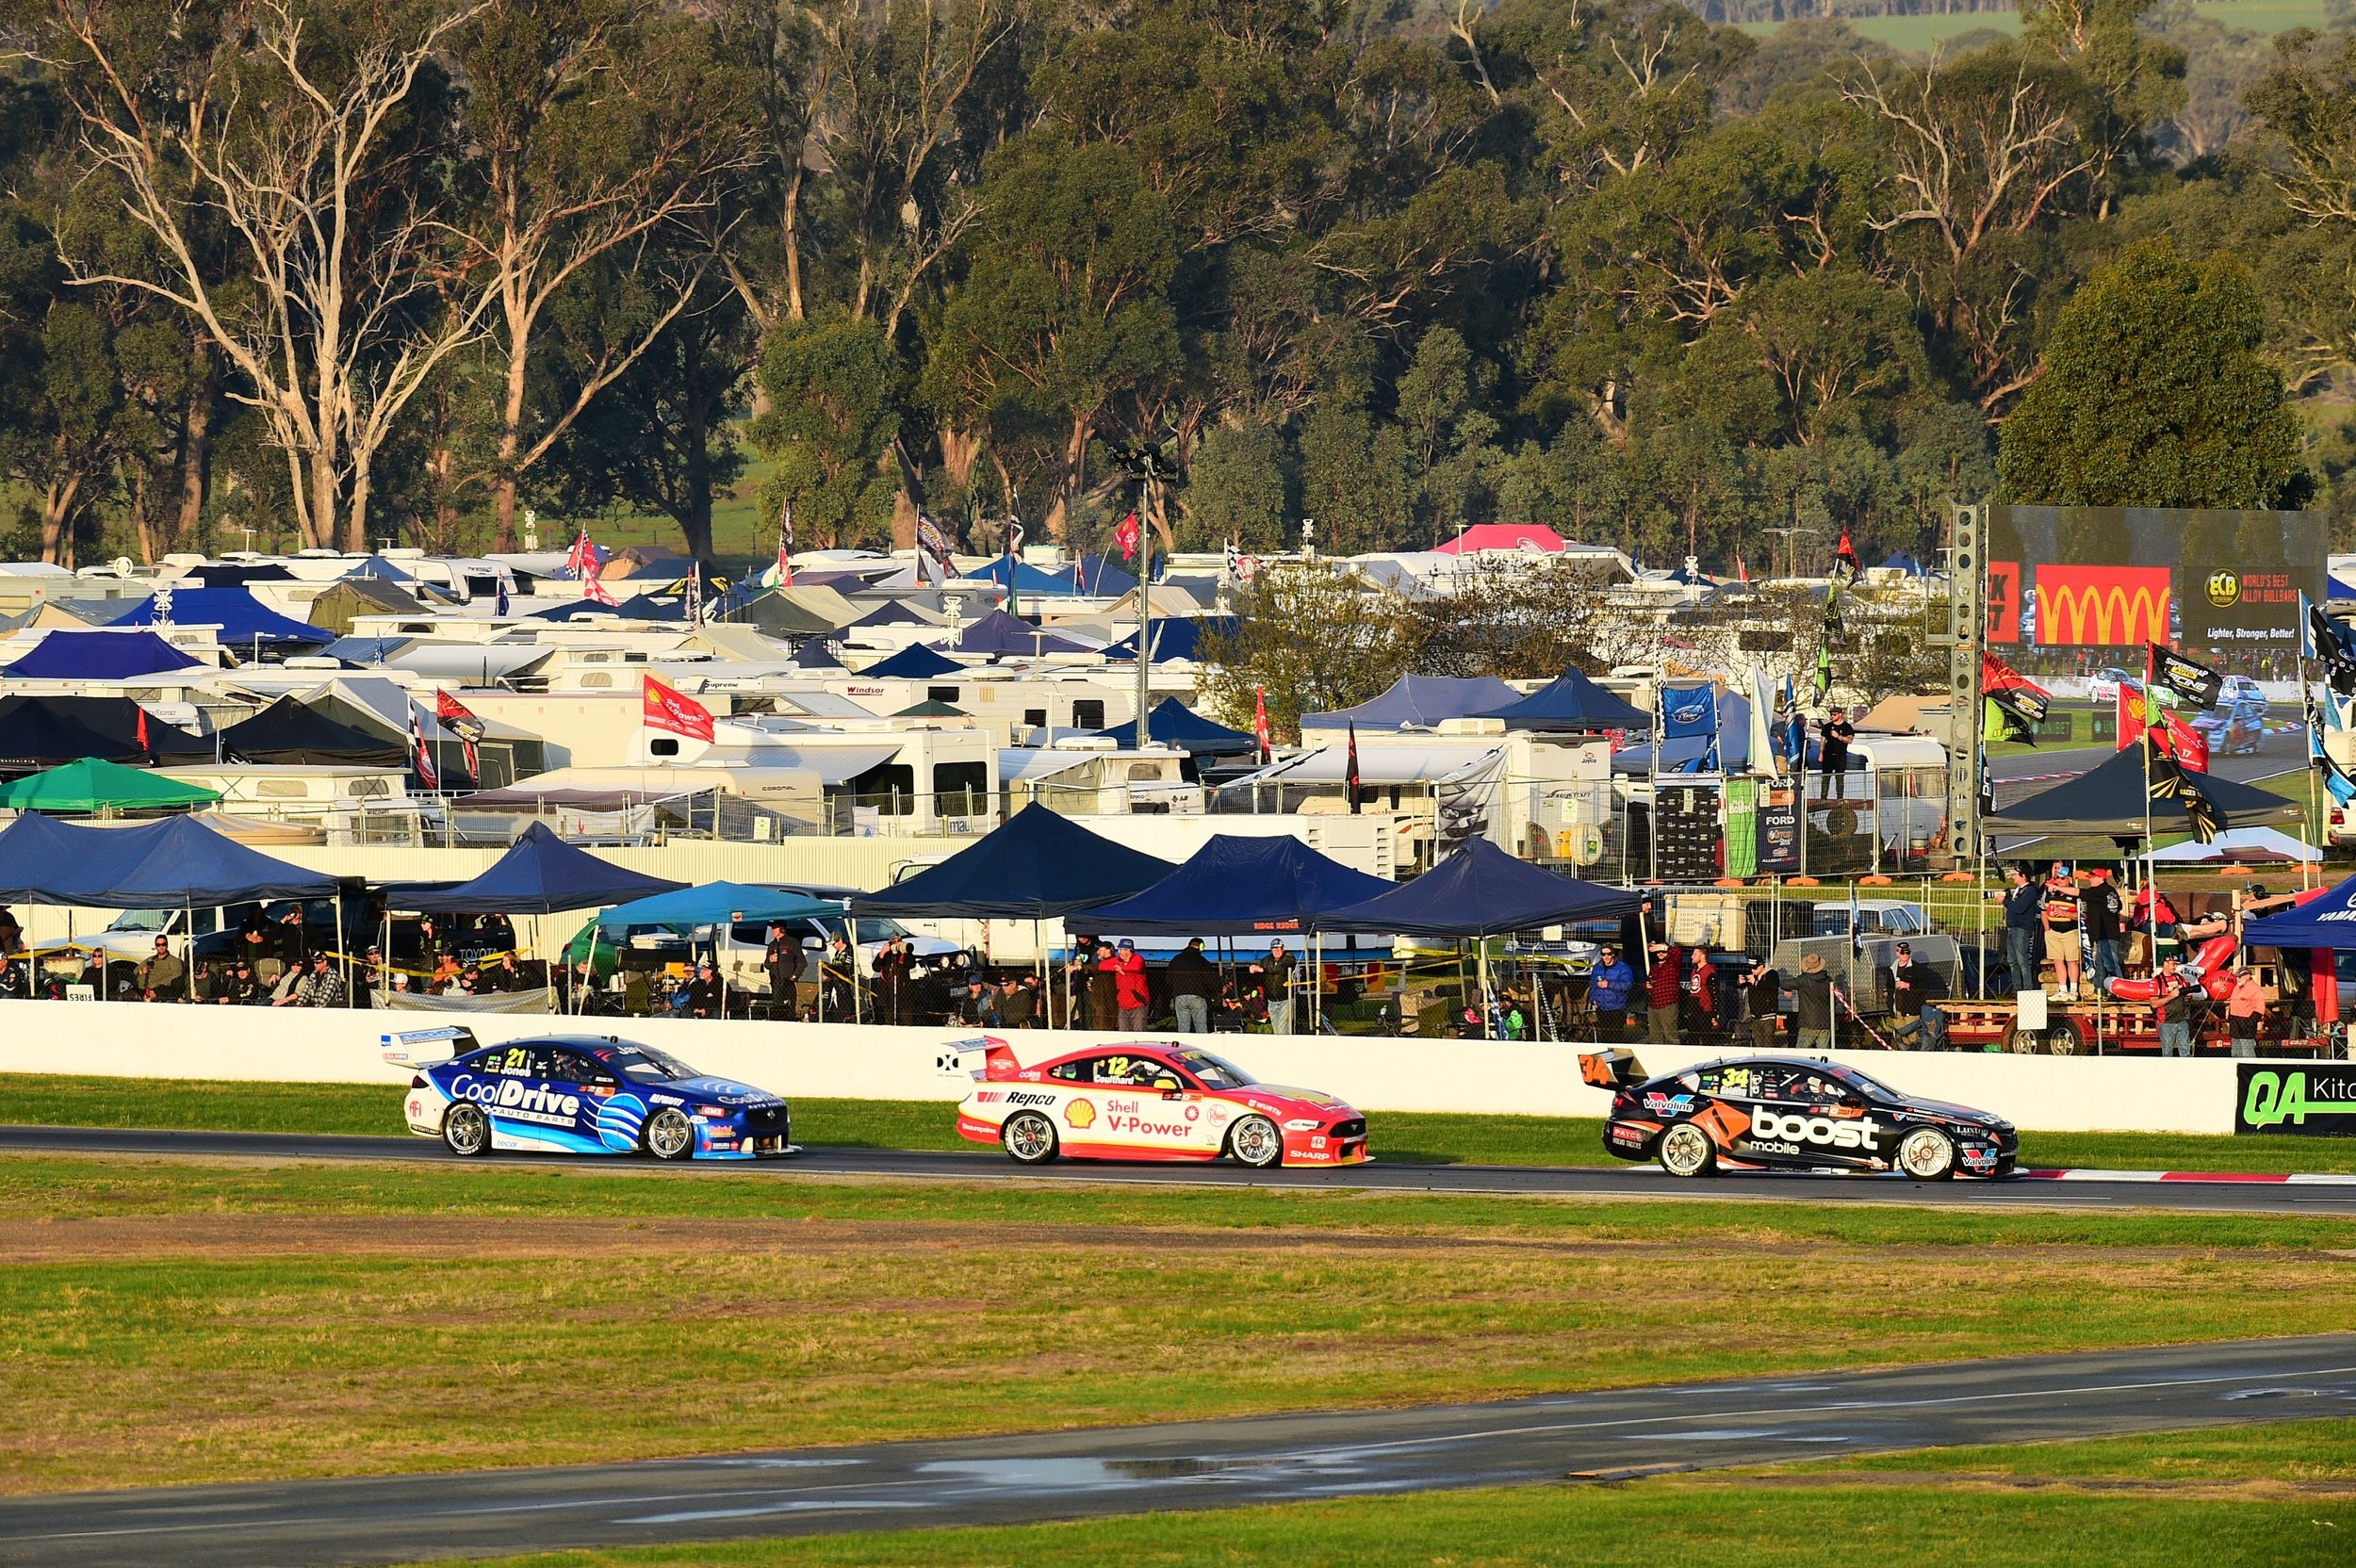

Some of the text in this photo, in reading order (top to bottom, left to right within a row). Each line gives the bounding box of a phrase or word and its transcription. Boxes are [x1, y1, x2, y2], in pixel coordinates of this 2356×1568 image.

[2210, 573, 2236, 596] ECB
[2242, 574, 2289, 587] WORLD'S BEST
[2242, 589, 2262, 602] ALLOY
[2264, 590, 2298, 602] BULLBARS
[2207, 628, 2296, 640] Lighter, Stronger, Better!
[2165, 657, 2209, 678] SUPERCHEAP
[2174, 668, 2194, 677] AUTO
[847, 686, 885, 694] Windsor
[1765, 816, 1795, 825] FORD
[1276, 922, 1300, 930] RYDER
[459, 948, 498, 959] TOYOTA
[505, 1048, 527, 1068] 21
[500, 1066, 532, 1078] Jones
[1108, 1056, 1129, 1076] 12
[1579, 1054, 1609, 1086] 34
[1019, 1070, 1041, 1079] coles
[1093, 1075, 1135, 1086] Coulthard
[1722, 1068, 1750, 1088] 34
[450, 1074, 581, 1116] CoolDrive
[1006, 1092, 1055, 1106] Repco
[2243, 1071, 2306, 1130] QA
[1107, 1101, 1138, 1113] Shell
[1643, 1099, 1695, 1113] Valvoline
[499, 1109, 574, 1126] AUTO PARTS
[1108, 1115, 1192, 1137] V-Power
[1751, 1104, 1880, 1151] boost
[1956, 1125, 1988, 1137] Luxtop
[1750, 1140, 1800, 1155] mobile
[1289, 1150, 1330, 1160] SHARP
[1961, 1157, 1998, 1167] Valvoline
